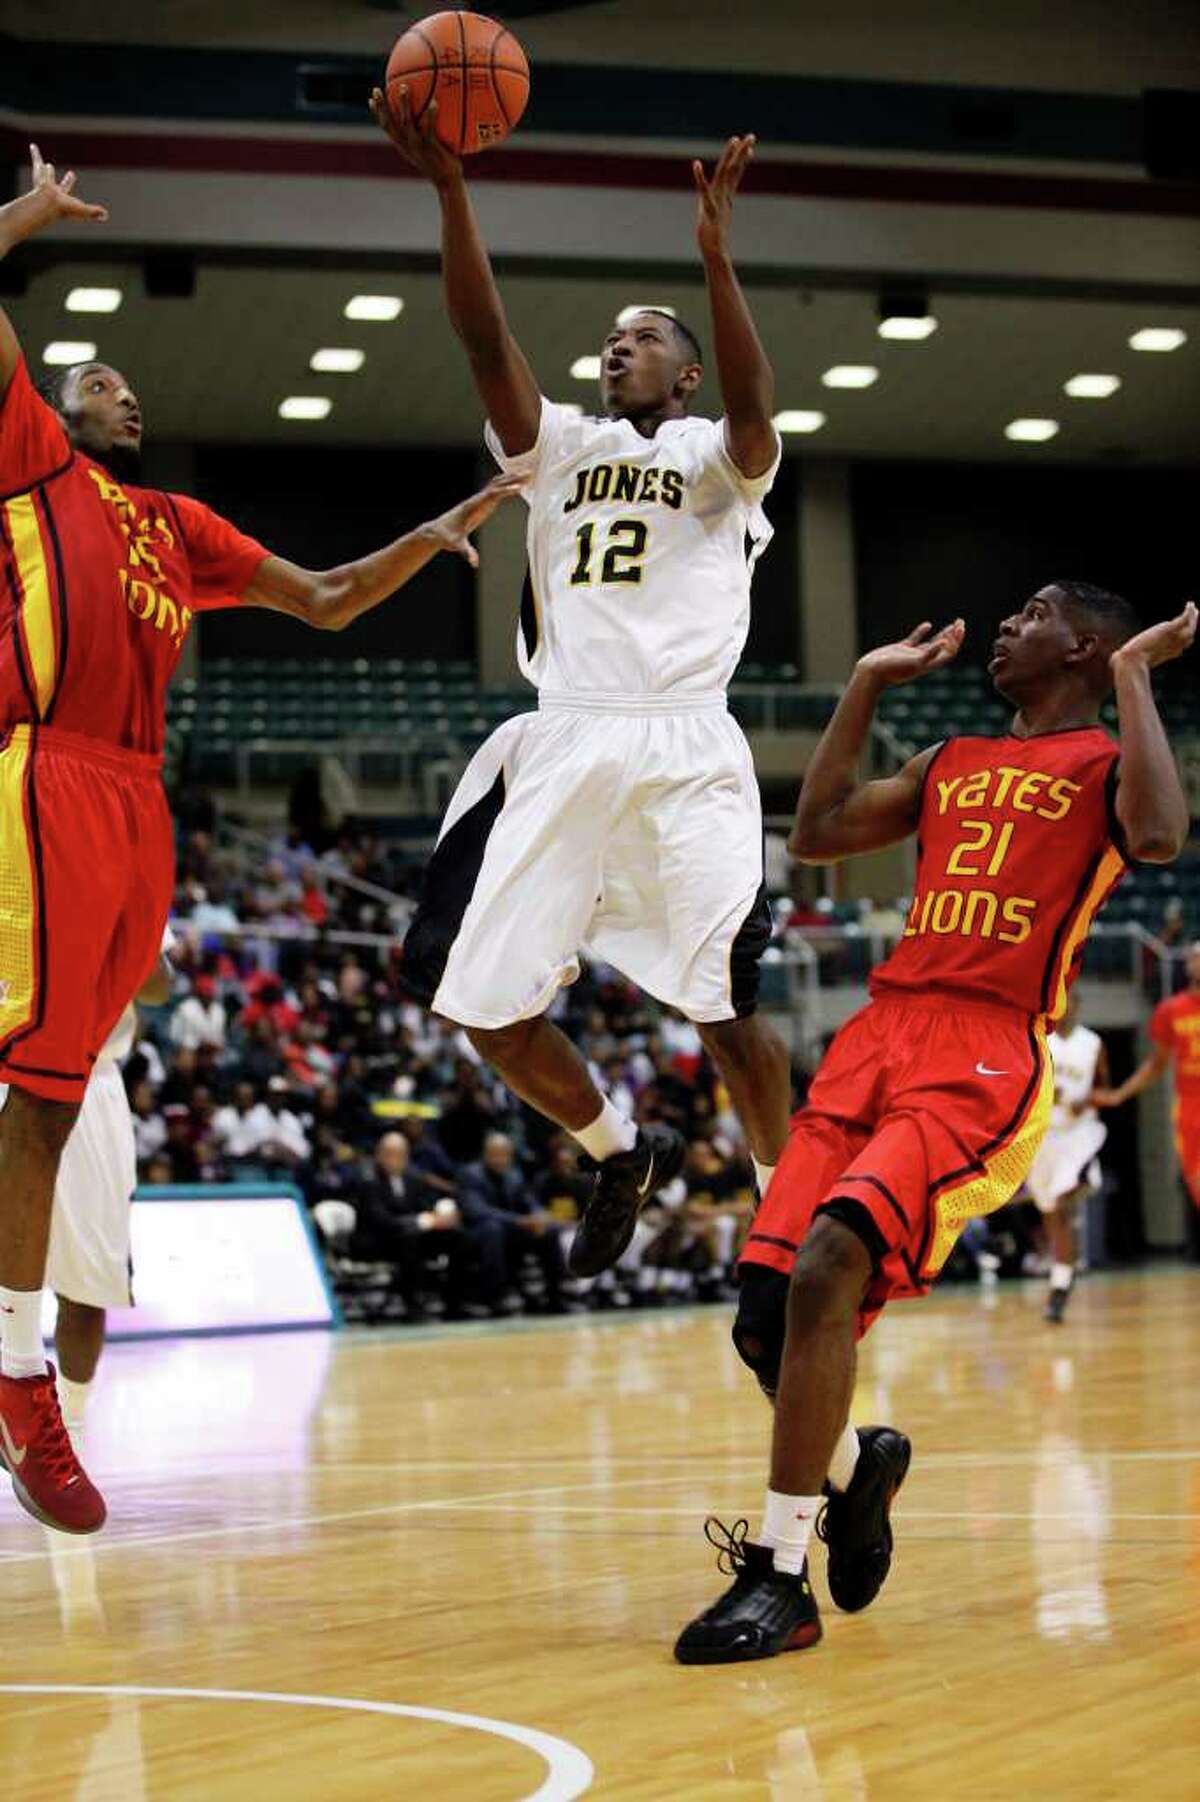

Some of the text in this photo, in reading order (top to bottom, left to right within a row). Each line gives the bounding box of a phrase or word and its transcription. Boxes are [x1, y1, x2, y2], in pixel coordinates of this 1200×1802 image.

[562, 463, 684, 513] JONES
[569, 519, 648, 585] 12
[946, 820, 1015, 877] 21
